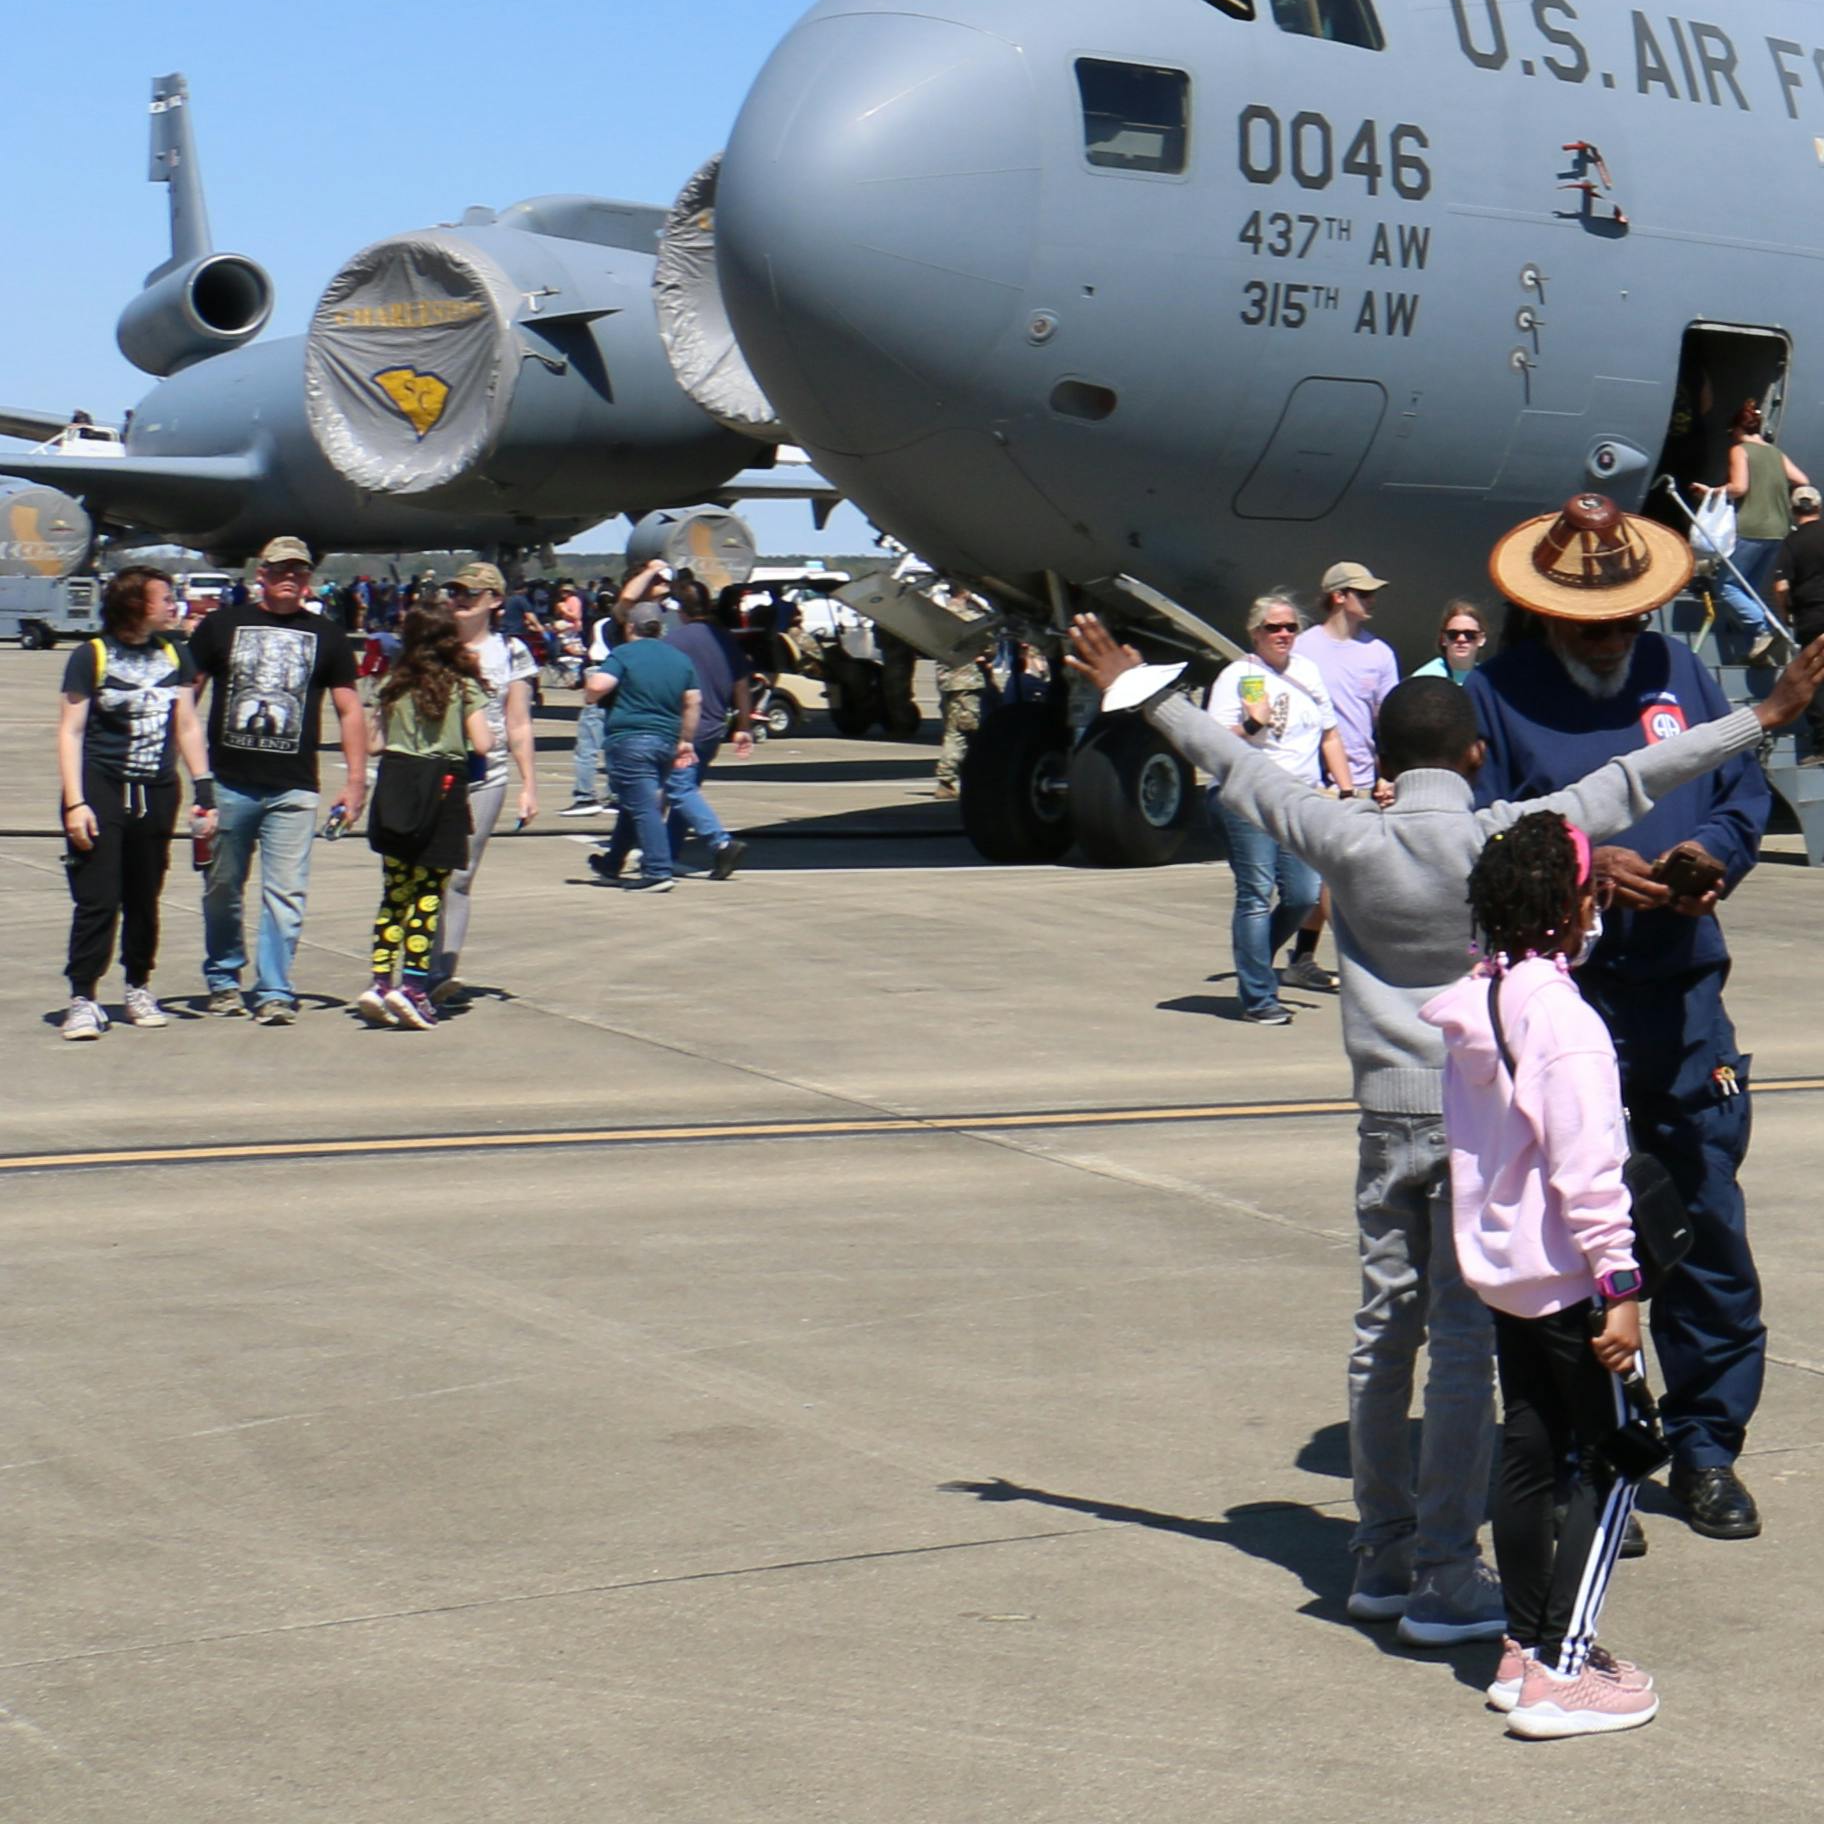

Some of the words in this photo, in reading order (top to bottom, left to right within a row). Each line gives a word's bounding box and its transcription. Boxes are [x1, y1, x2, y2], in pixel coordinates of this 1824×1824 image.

[1632, 9, 1750, 111] AIR
[1238, 104, 1431, 201] 0046
[1369, 222, 1430, 270] AW
[1354, 290, 1420, 337] AW
[259, 738, 291, 750] END
